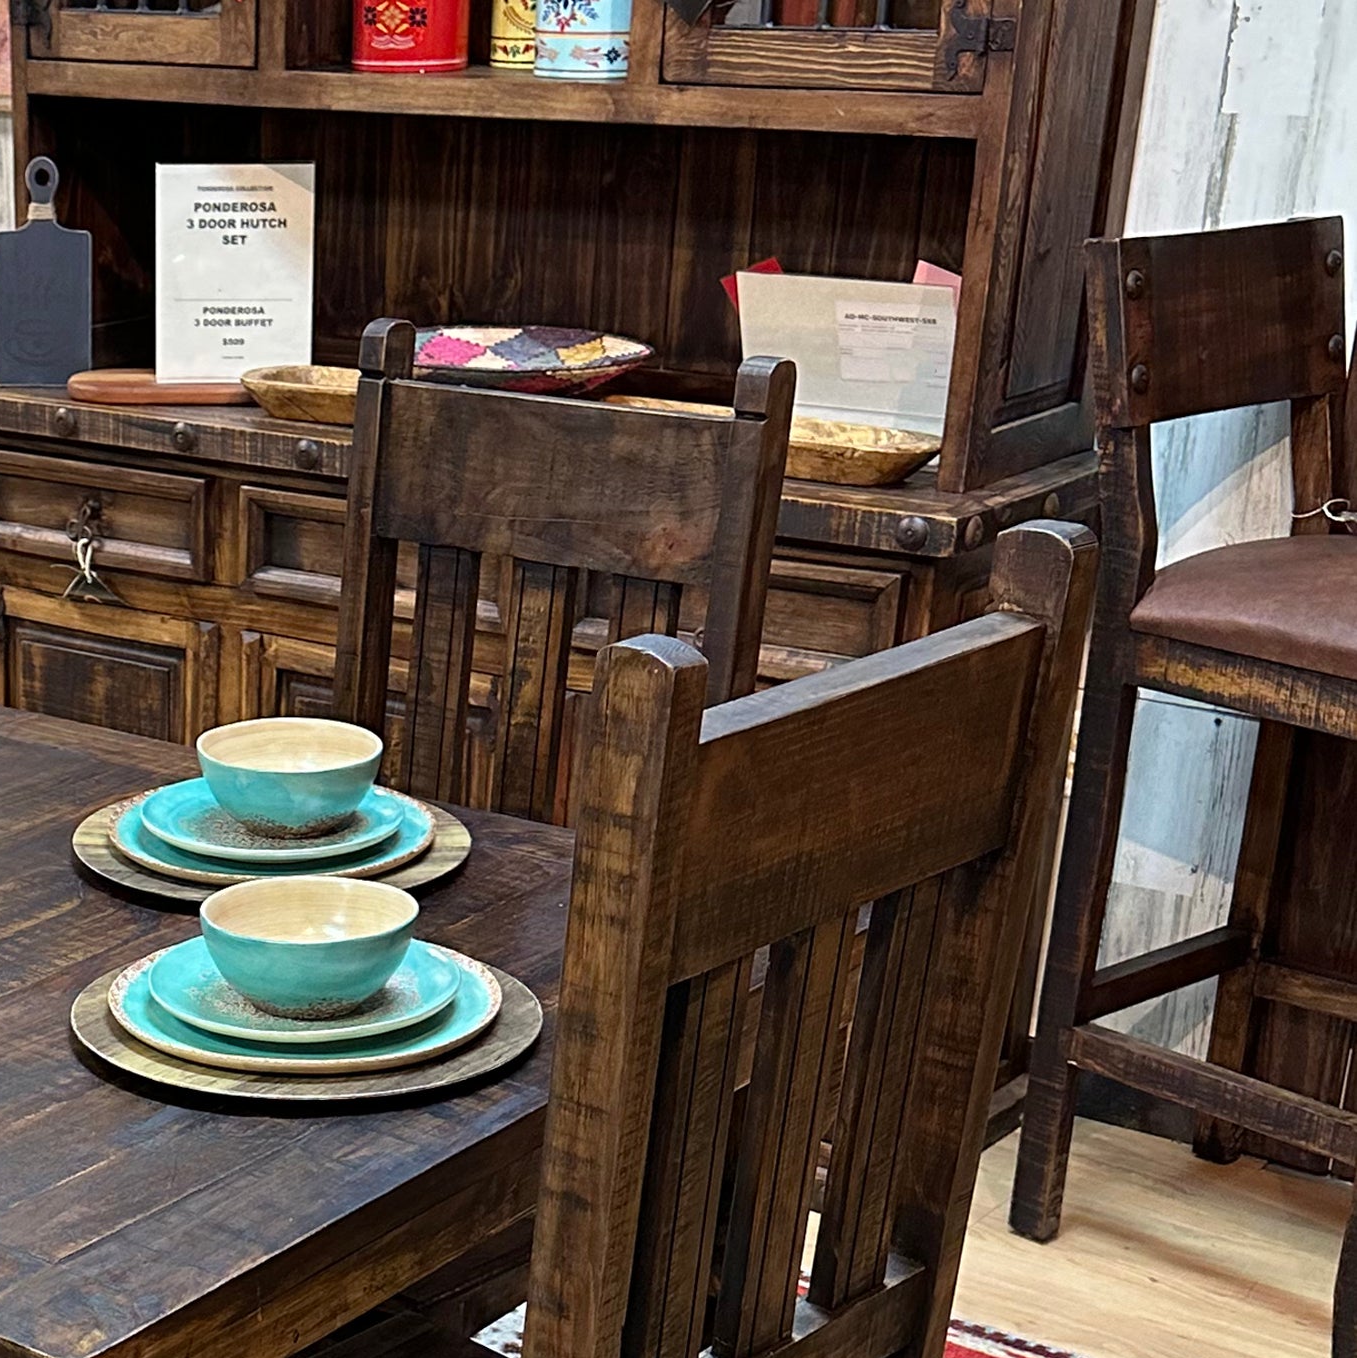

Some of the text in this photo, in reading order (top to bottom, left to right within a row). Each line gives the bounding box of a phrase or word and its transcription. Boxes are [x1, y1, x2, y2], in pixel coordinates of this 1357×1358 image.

[193, 202, 277, 213] PONDEROSA
[186, 218, 288, 229] 3 DOOR HUTCH
[222, 234, 247, 245] SET
[202, 306, 266, 315] PONDEROSA
[194, 318, 274, 327] 3 DOOR BUFFET
